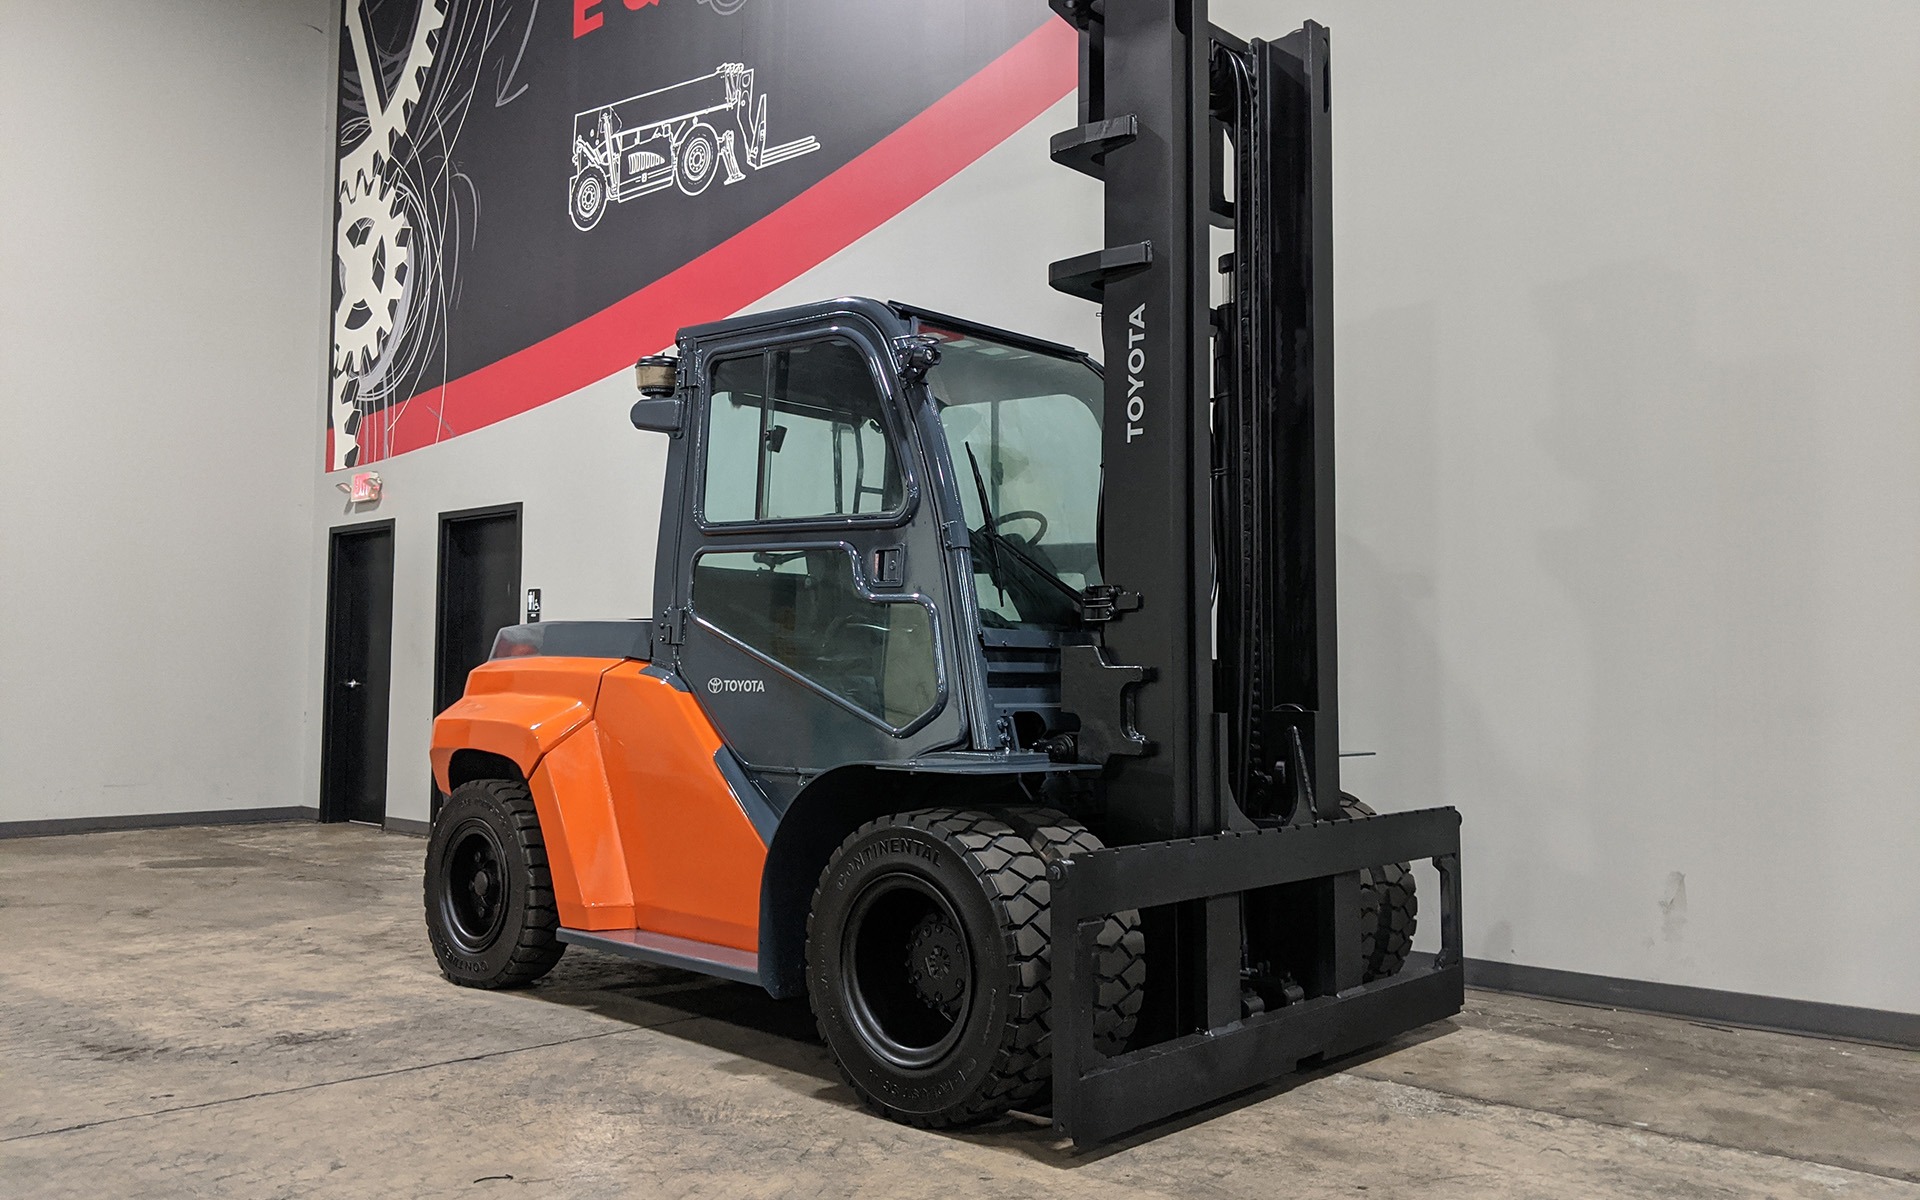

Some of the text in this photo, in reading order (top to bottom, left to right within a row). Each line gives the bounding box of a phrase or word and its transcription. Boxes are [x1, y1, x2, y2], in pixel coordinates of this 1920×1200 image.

[1126, 302, 1146, 444] TOYOTA
[723, 679, 766, 693] TOYOTA
[836, 837, 943, 891] CONTINENTAL
